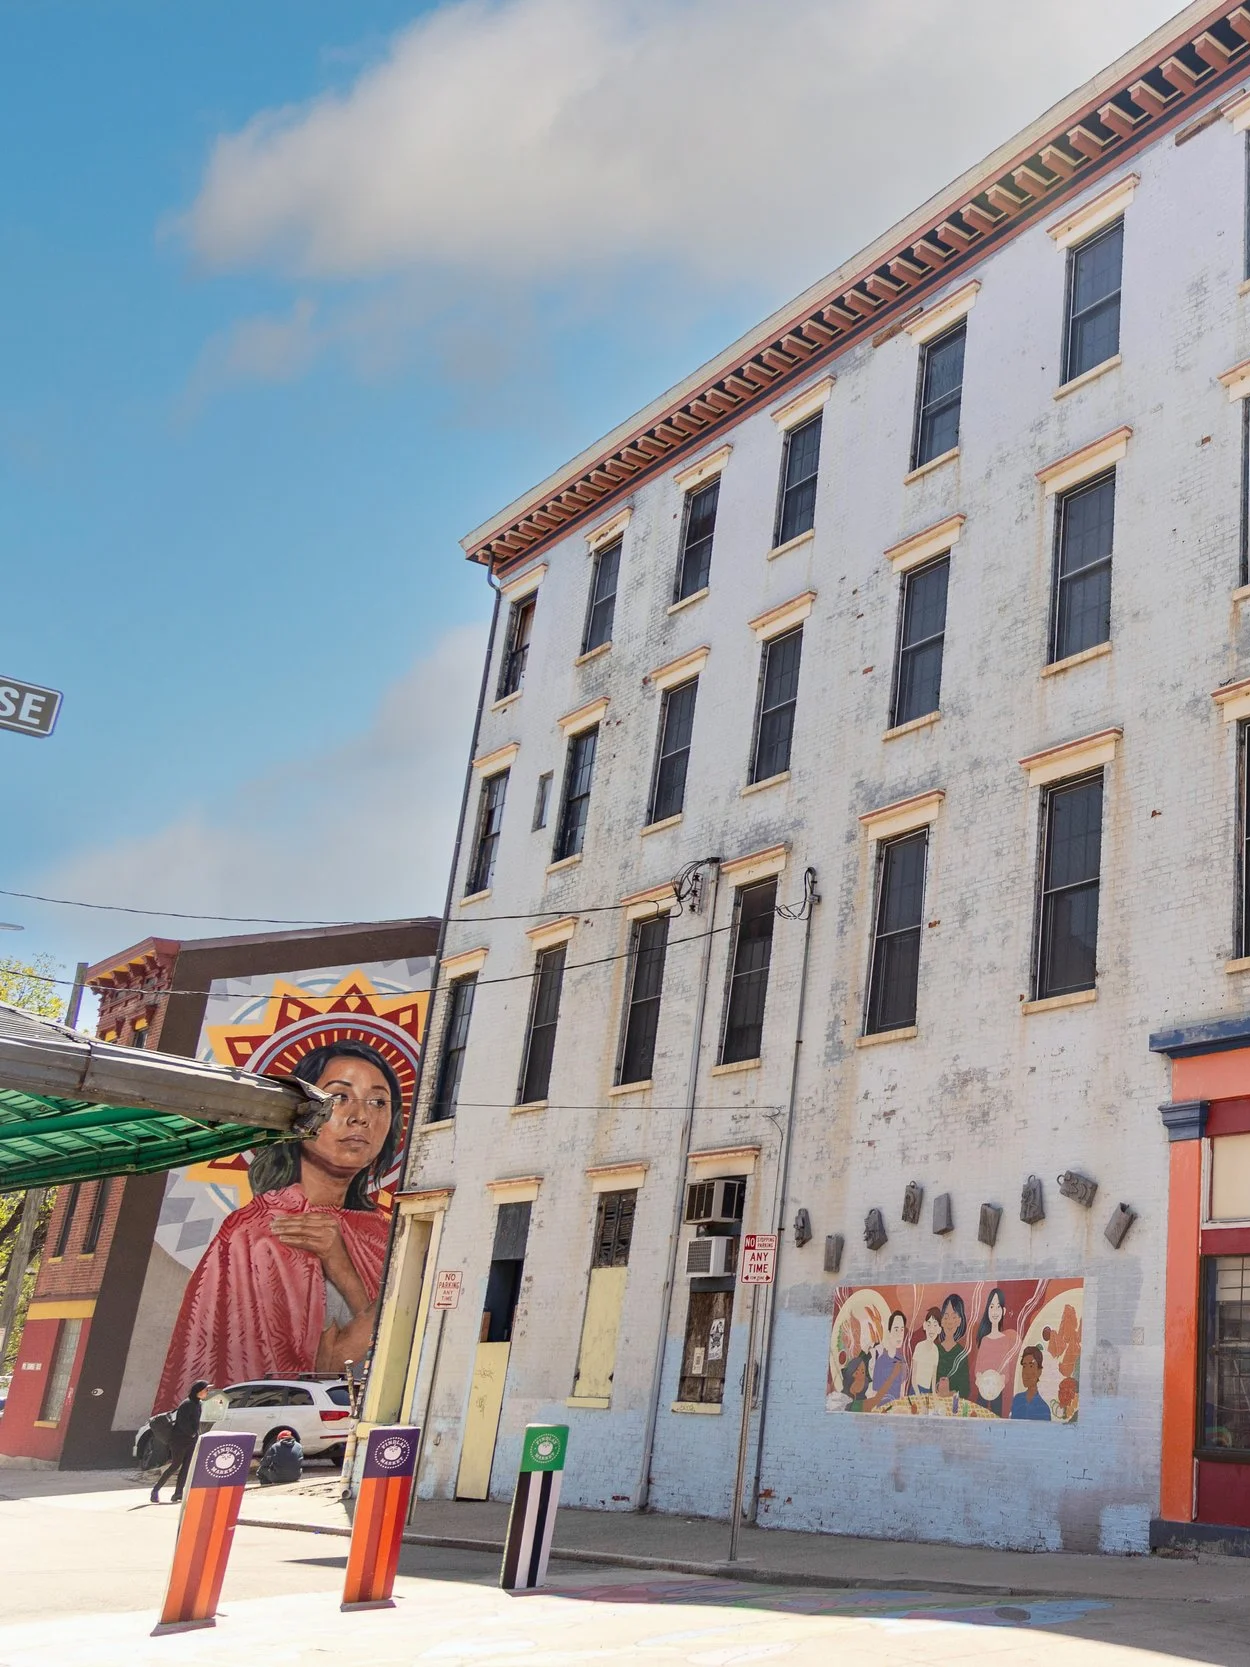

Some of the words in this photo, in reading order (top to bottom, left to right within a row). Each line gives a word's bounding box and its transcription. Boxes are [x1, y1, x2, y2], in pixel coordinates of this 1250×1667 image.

[745, 1237, 755, 1247] NO
[750, 1252, 769, 1261] ANY
[748, 1263, 769, 1273] TIME
[445, 1273, 456, 1281] NO
[381, 1440, 406, 1449] FINDLAY
[213, 1447, 240, 1457] FINDLAY
[380, 1456, 404, 1465] MARKET
[211, 1465, 237, 1475] MARKET
